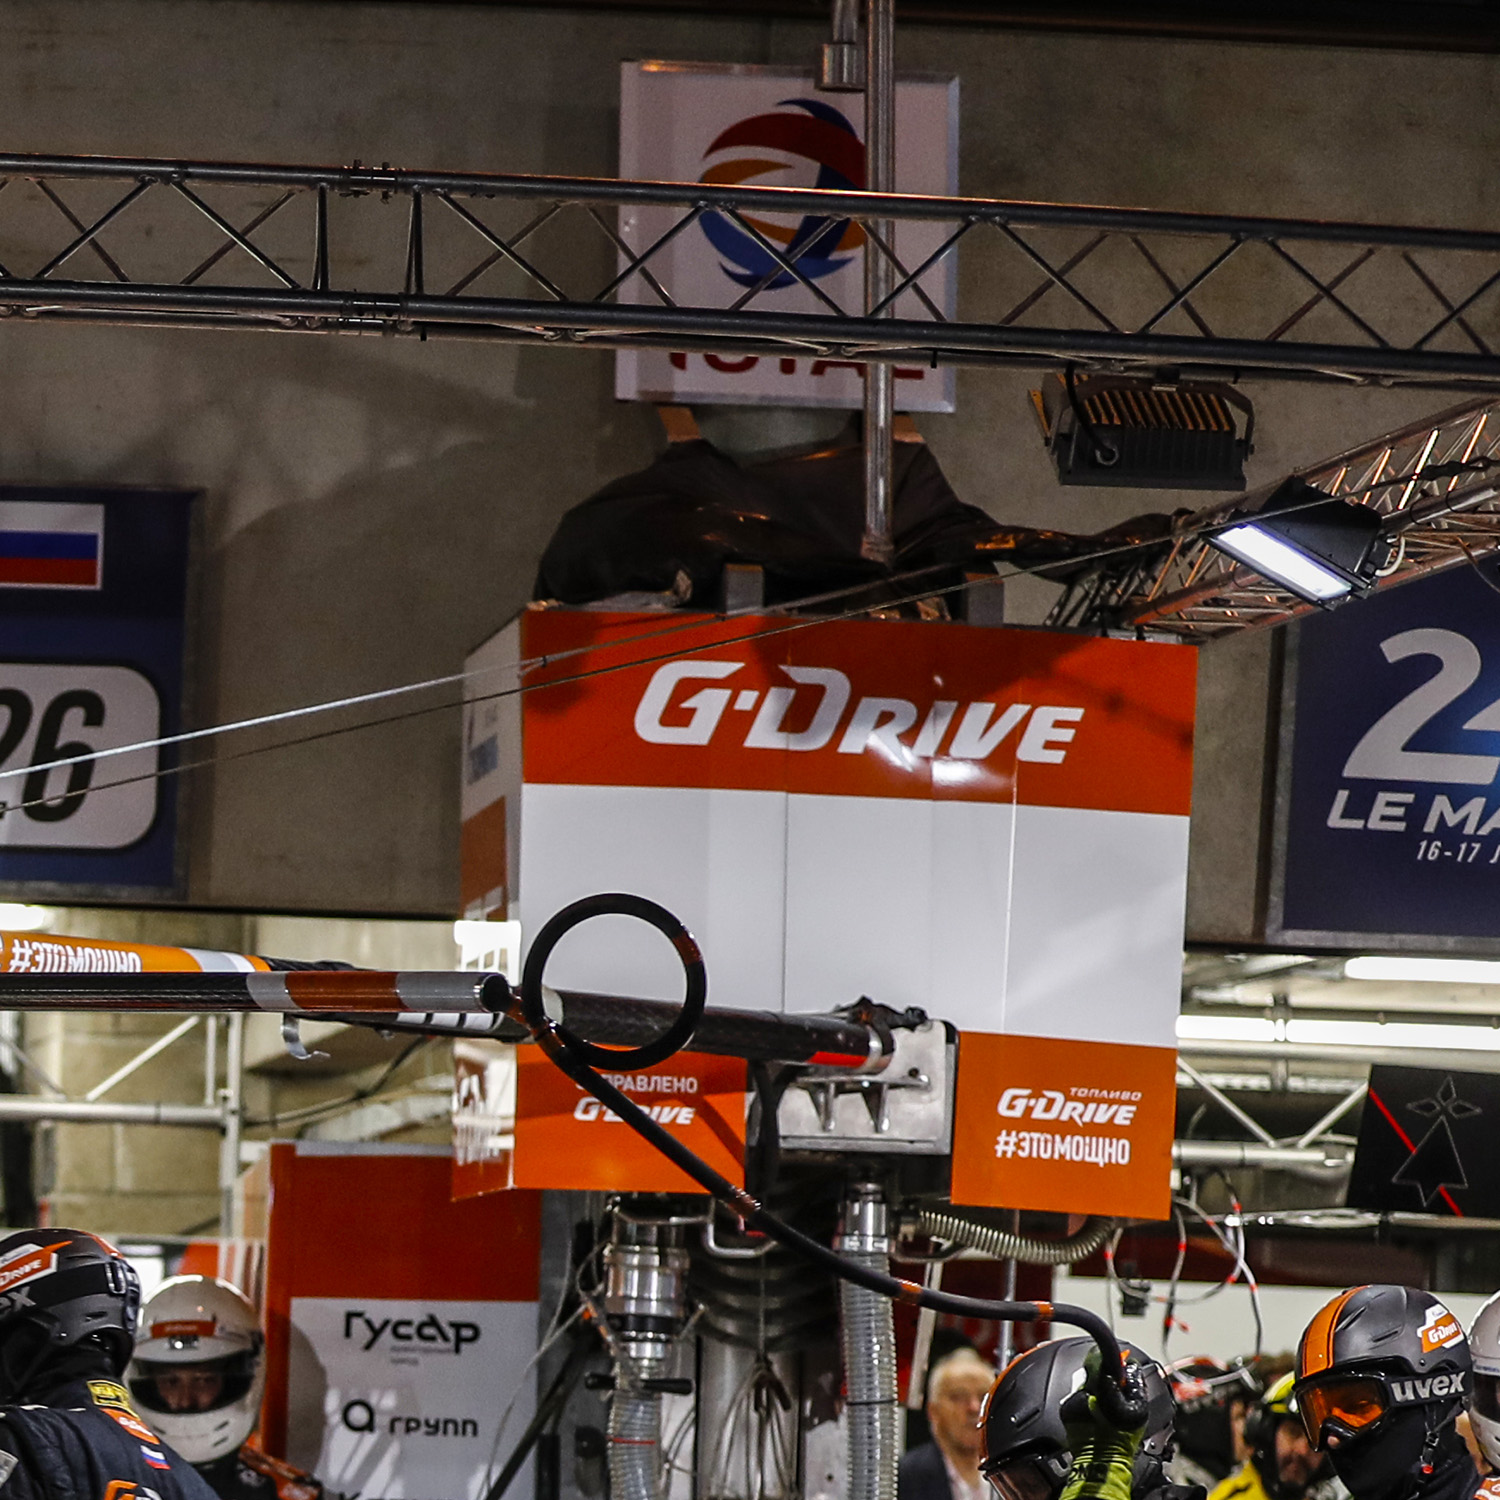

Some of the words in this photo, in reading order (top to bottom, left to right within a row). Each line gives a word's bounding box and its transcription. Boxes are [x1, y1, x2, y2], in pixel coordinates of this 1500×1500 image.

[1326, 789, 1416, 833] LE
[1416, 840, 1480, 864] 16-17
[994, 1129, 1131, 1167] #ЭТОМОЩНО
[1390, 1370, 1467, 1403] uvex
